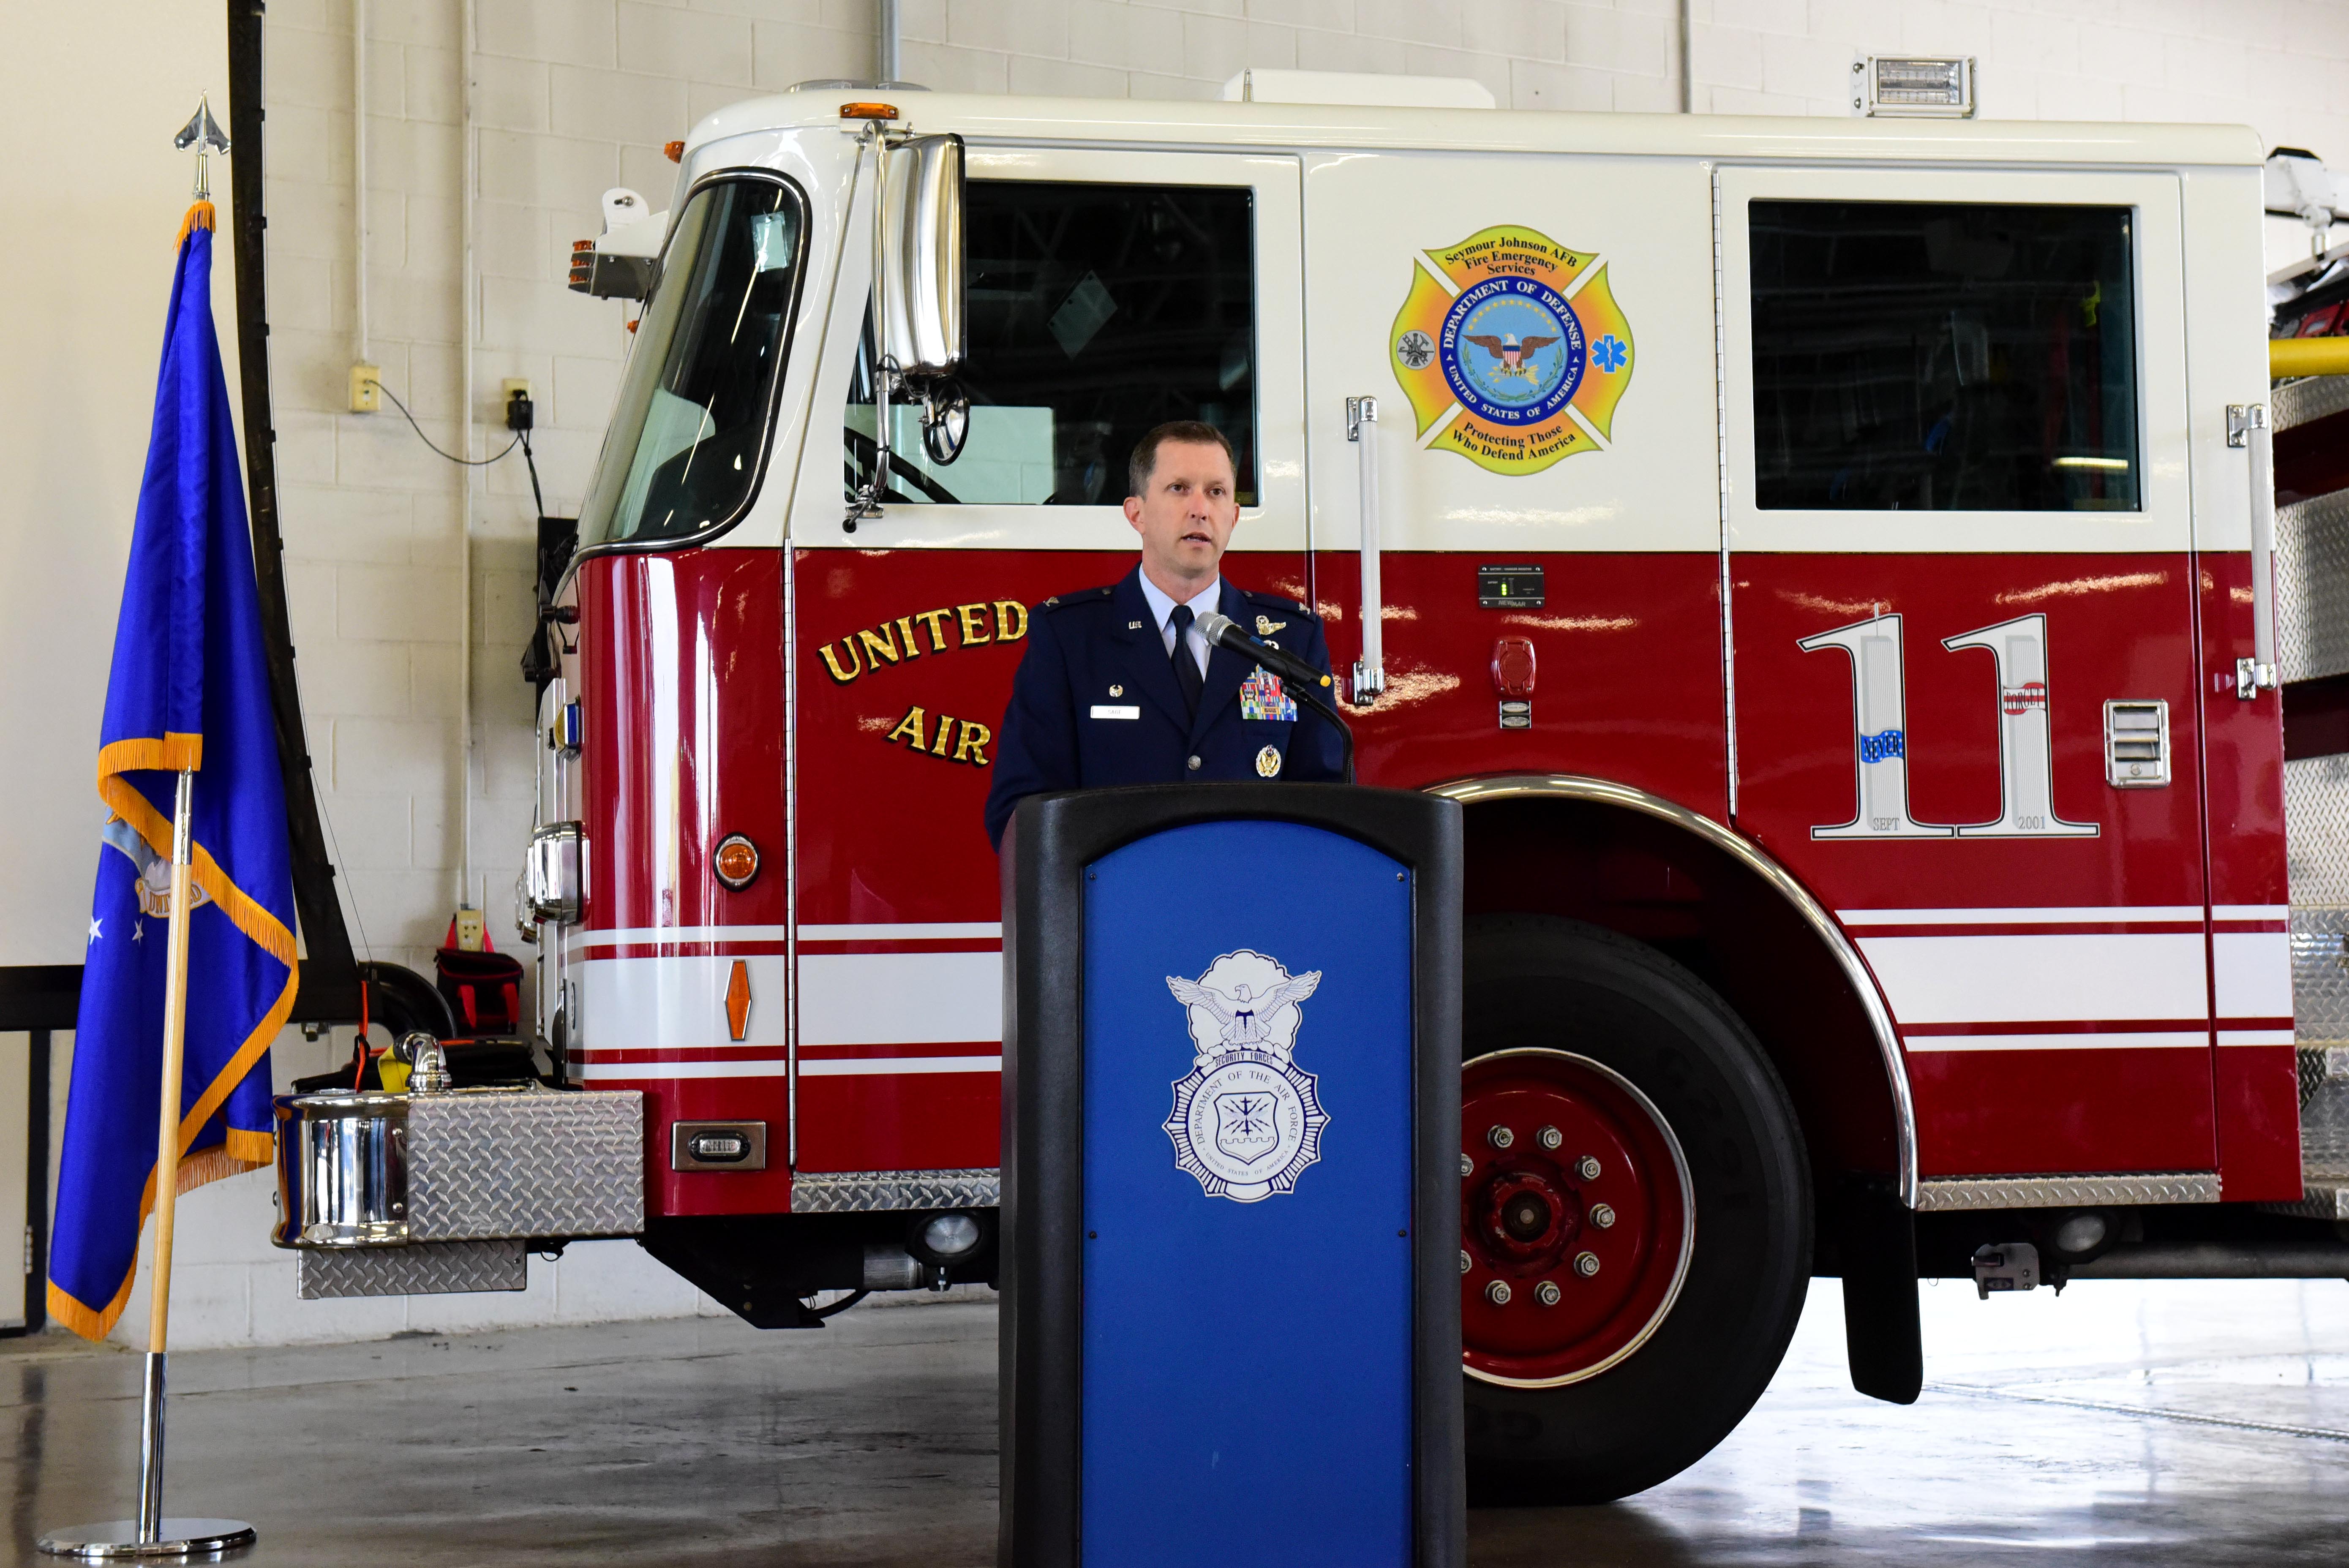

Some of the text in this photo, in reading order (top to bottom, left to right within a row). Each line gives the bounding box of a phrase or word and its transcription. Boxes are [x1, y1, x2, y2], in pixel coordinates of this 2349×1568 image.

[1445, 237, 1577, 267] Seymour Johnson AFB
[1464, 251, 1558, 272] Fire Emergency
[1487, 263, 1535, 275] Services
[1443, 280, 1581, 350] DEPARTMENT OF DEFENSE
[1449, 365, 1578, 419] UNITED STATES OF AMERICA
[1453, 429, 1576, 460] Who Defend America
[1463, 422, 1563, 449] Protecting Those
[818, 600, 1028, 684] UNITED
[2006, 688, 2040, 712] FORGET
[887, 706, 991, 767] AIR
[1796, 612, 2100, 839] 11
[1864, 735, 1900, 759] NEVER
[1873, 816, 2045, 830] SEPT 2001
[149, 884, 202, 913] UNID
[1215, 1052, 1273, 1067] SECURITY FORCES
[1194, 1070, 1298, 1145] DEPARTMENT OF THE AIR FORCE
[1206, 1152, 1224, 1170] UNITED
[1267, 1150, 1289, 1170] AMERICA
